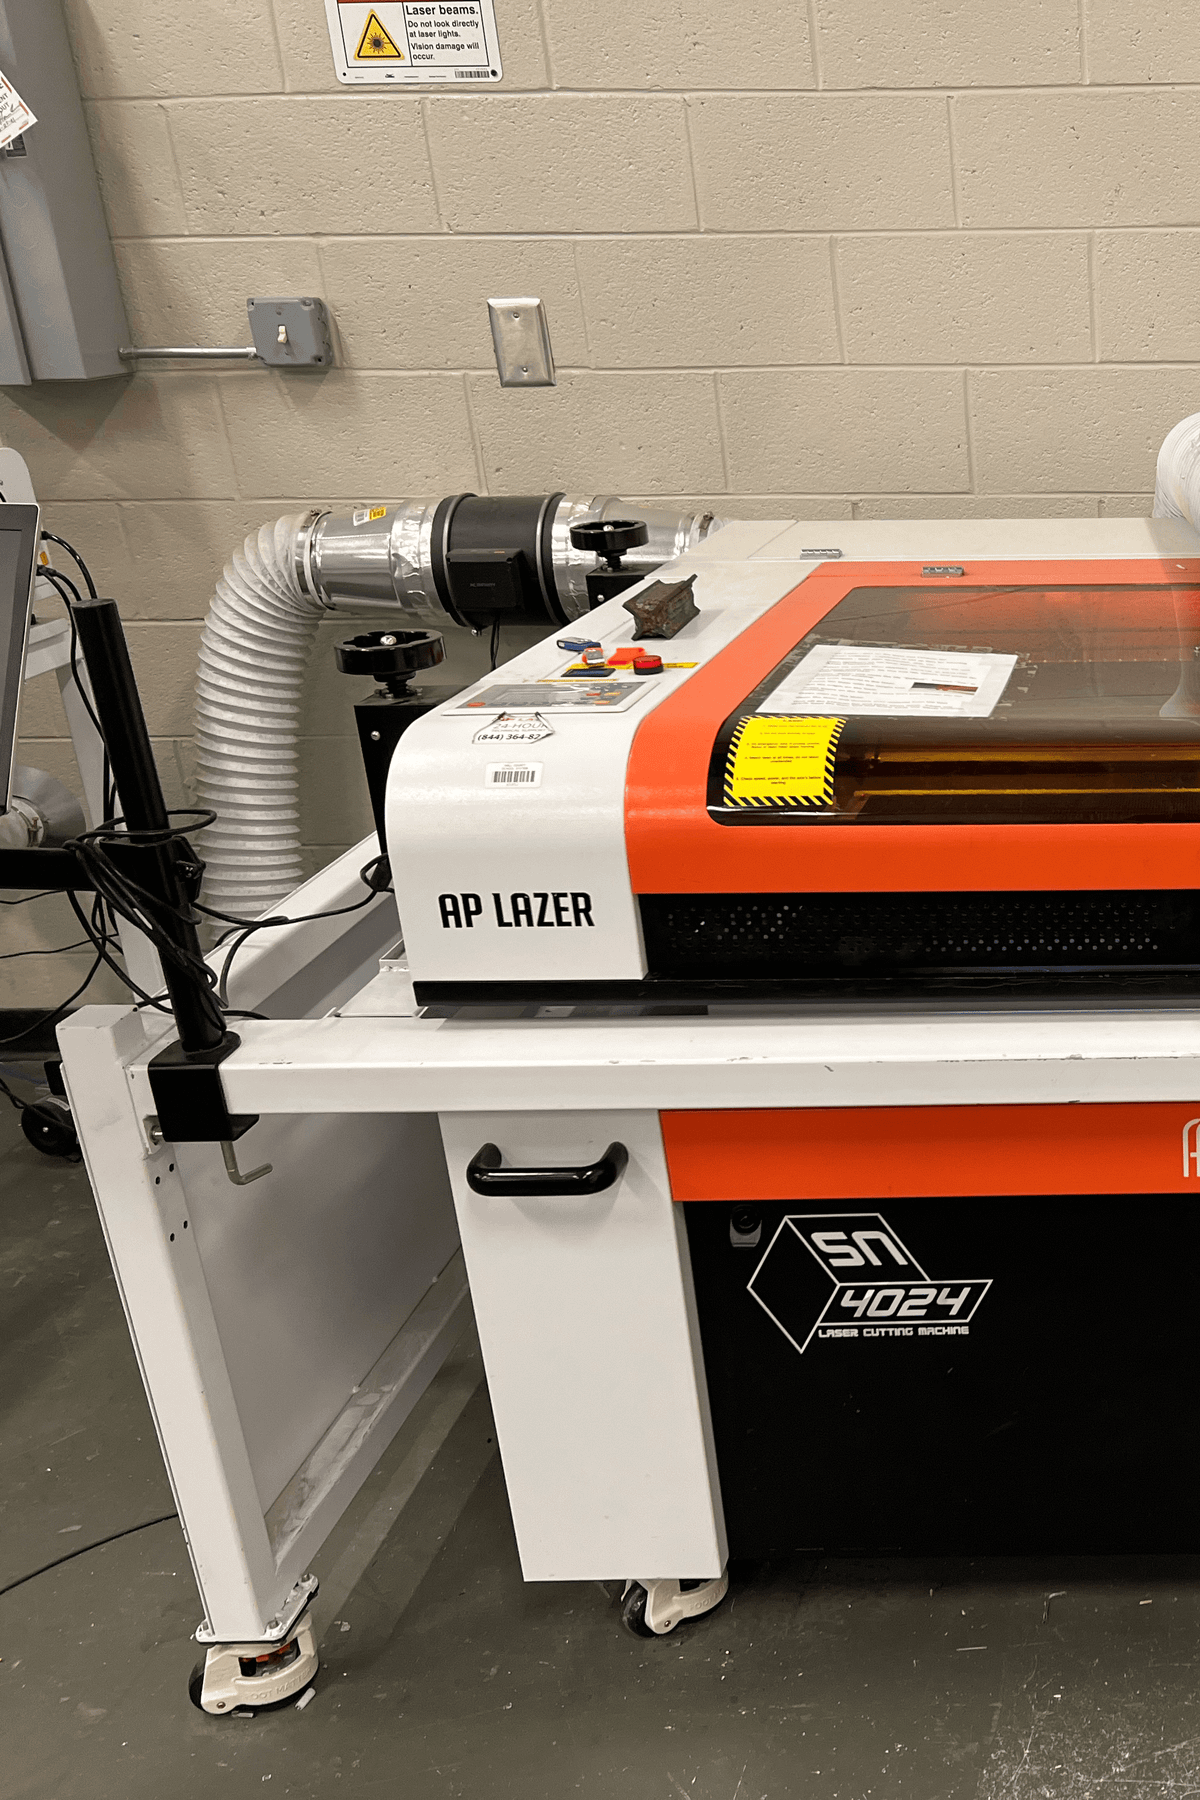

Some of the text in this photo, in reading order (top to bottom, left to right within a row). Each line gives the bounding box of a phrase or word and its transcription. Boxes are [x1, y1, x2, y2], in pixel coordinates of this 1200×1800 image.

[406, 5, 479, 15] Laser beams.
[438, 30, 461, 38] lights.
[436, 43, 465, 51] damage
[438, 892, 595, 928] AP LAZER
[811, 1231, 908, 1267] SN
[840, 1287, 971, 1318] 4024
[818, 1326, 969, 1338] LASER CUTTING MACHINE
